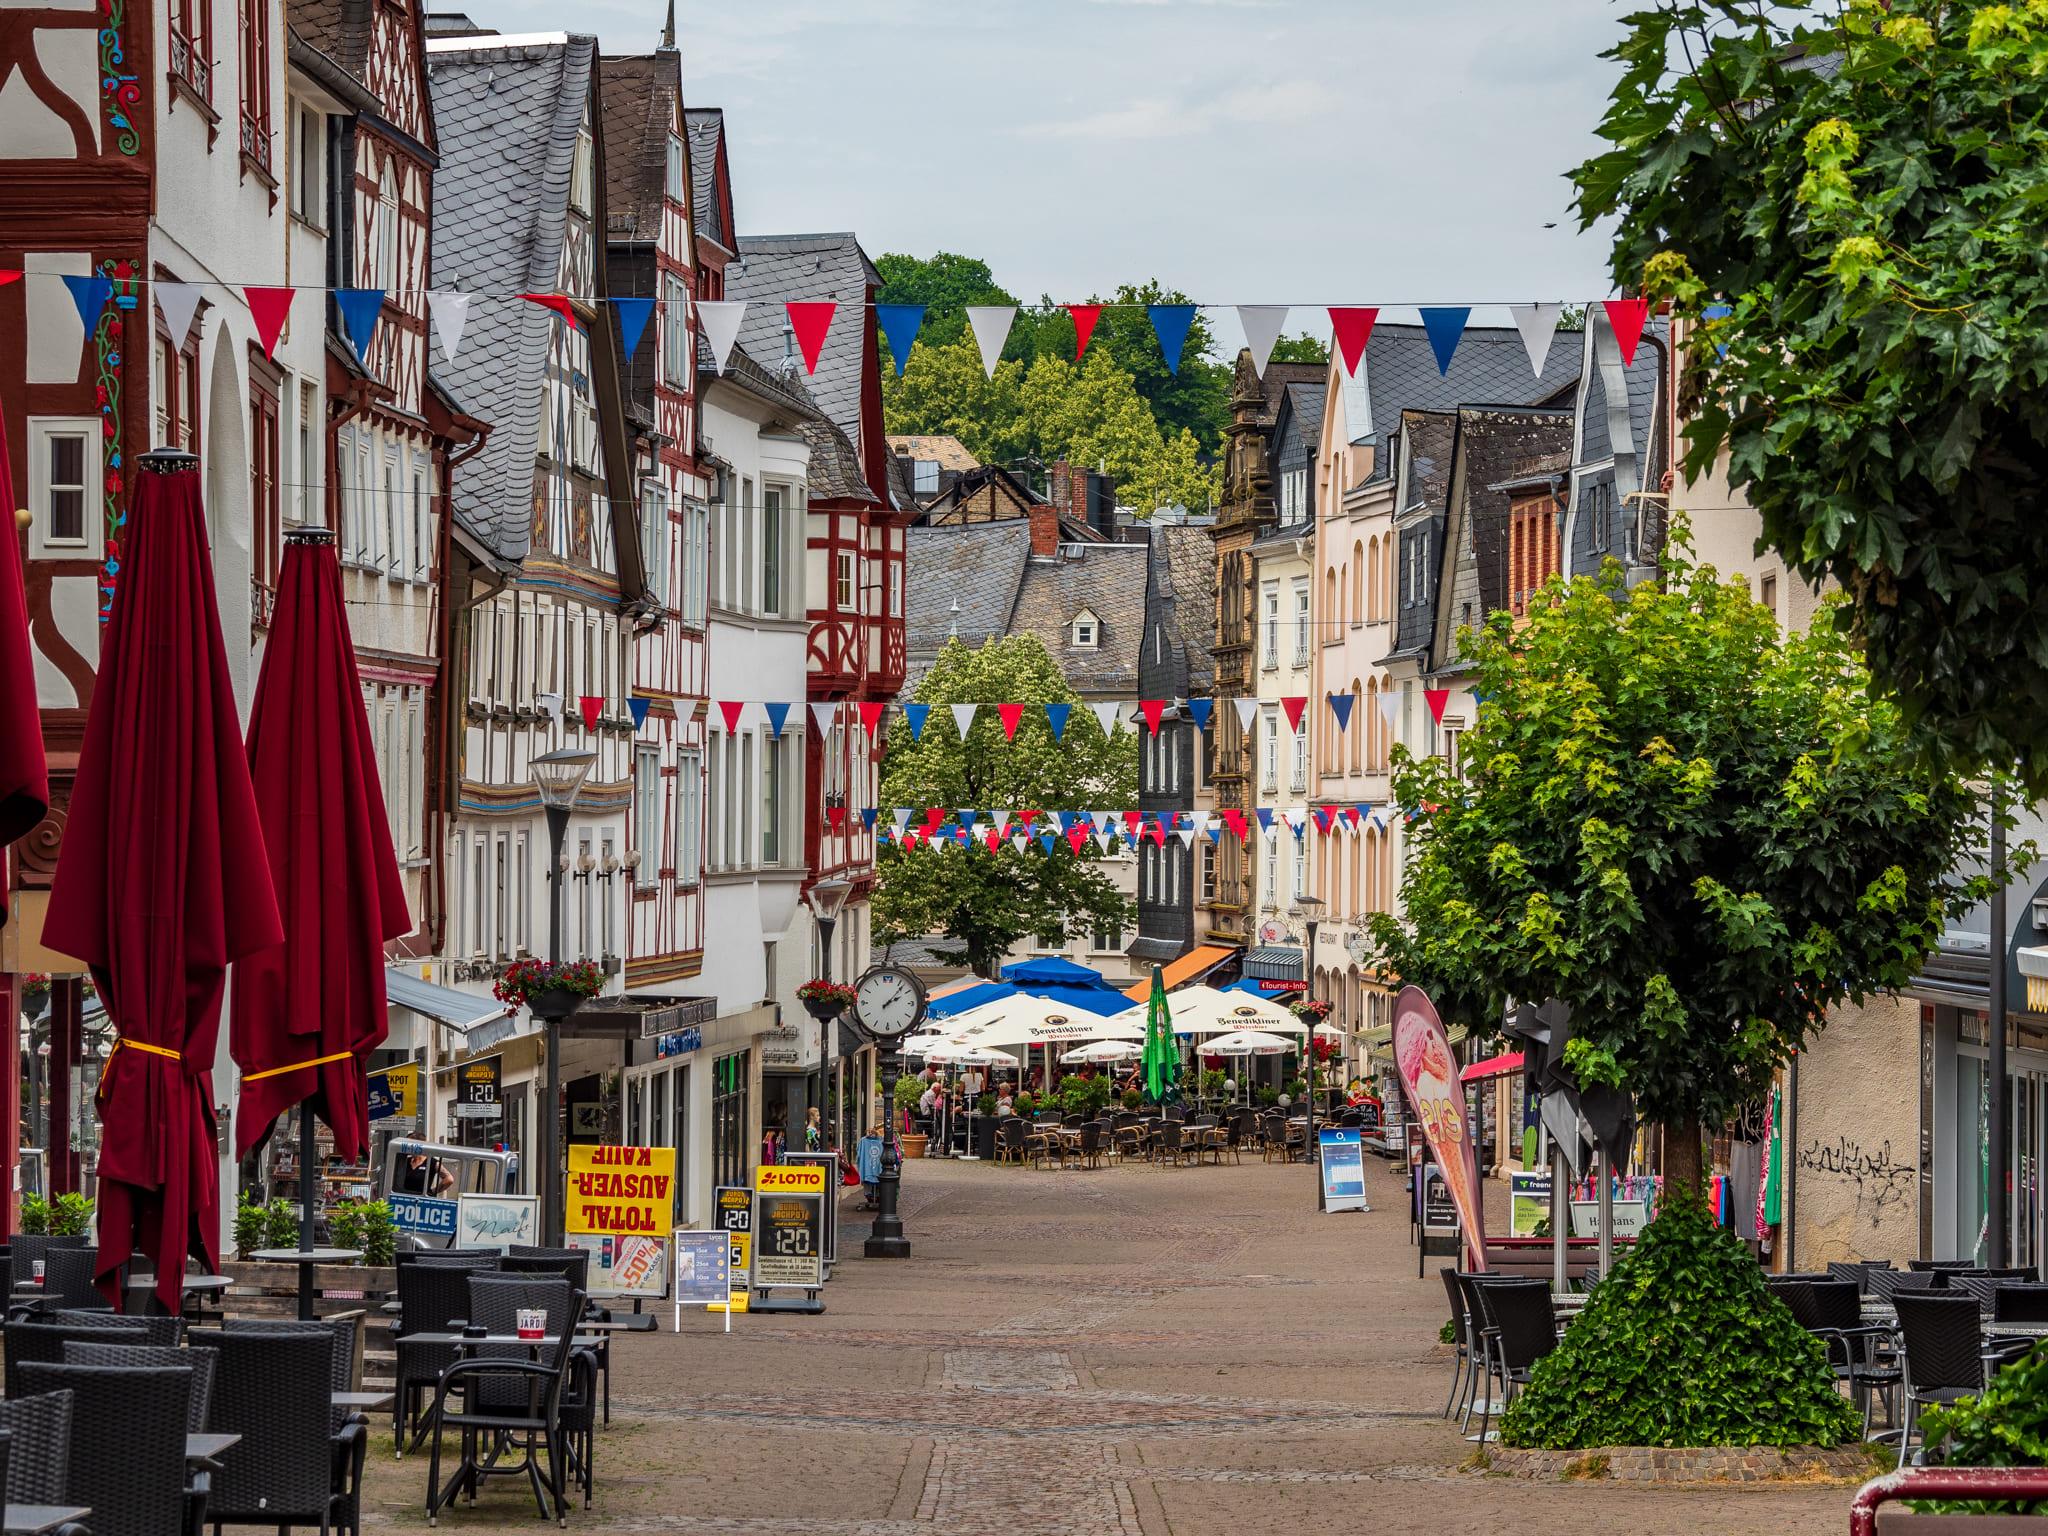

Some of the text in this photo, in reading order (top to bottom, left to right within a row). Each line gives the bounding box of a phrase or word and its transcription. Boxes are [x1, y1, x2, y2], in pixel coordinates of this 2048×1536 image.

[1265, 981, 1307, 990] Tourist-Info
[470, 1085, 494, 1103] 120
[572, 1173, 669, 1199] AUSVER-
[779, 1174, 820, 1184] LOTTO
[393, 1203, 451, 1226] POLICE
[582, 1205, 656, 1231] TOTAL
[725, 1210, 749, 1229] 120
[776, 1229, 810, 1254] 120
